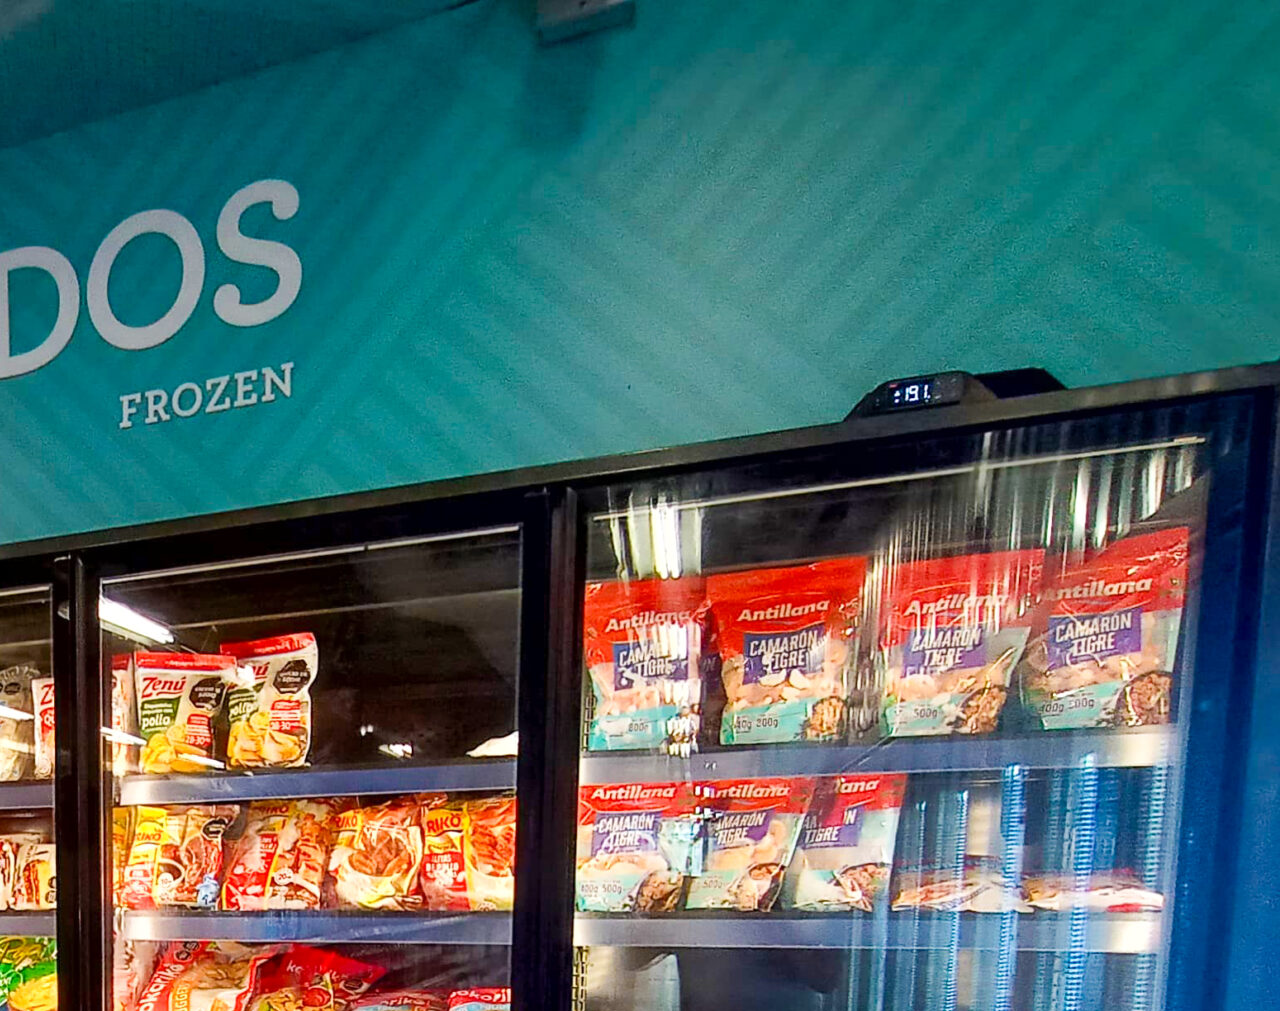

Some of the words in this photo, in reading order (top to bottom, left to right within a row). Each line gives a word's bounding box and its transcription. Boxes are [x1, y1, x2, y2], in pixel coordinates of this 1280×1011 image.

[119, 362, 294, 429] FROZEN
[736, 600, 830, 622] Antillana
[904, 592, 1008, 618] Antillana
[604, 610, 692, 634] Antillana
[1055, 612, 1132, 642] CAMARÓN
[749, 629, 820, 657] CAMARÓN
[1070, 633, 1116, 655] TIGRE
[768, 650, 807, 671] TIGRE
[924, 647, 963, 666] TIGRE
[141, 676, 186, 699] Zenú
[591, 785, 676, 800] Antillana
[597, 813, 655, 834] CAMARÓN
[712, 811, 767, 833] AMARÓN
[715, 827, 749, 845] TIGRE
[806, 827, 839, 843] TIGRE
